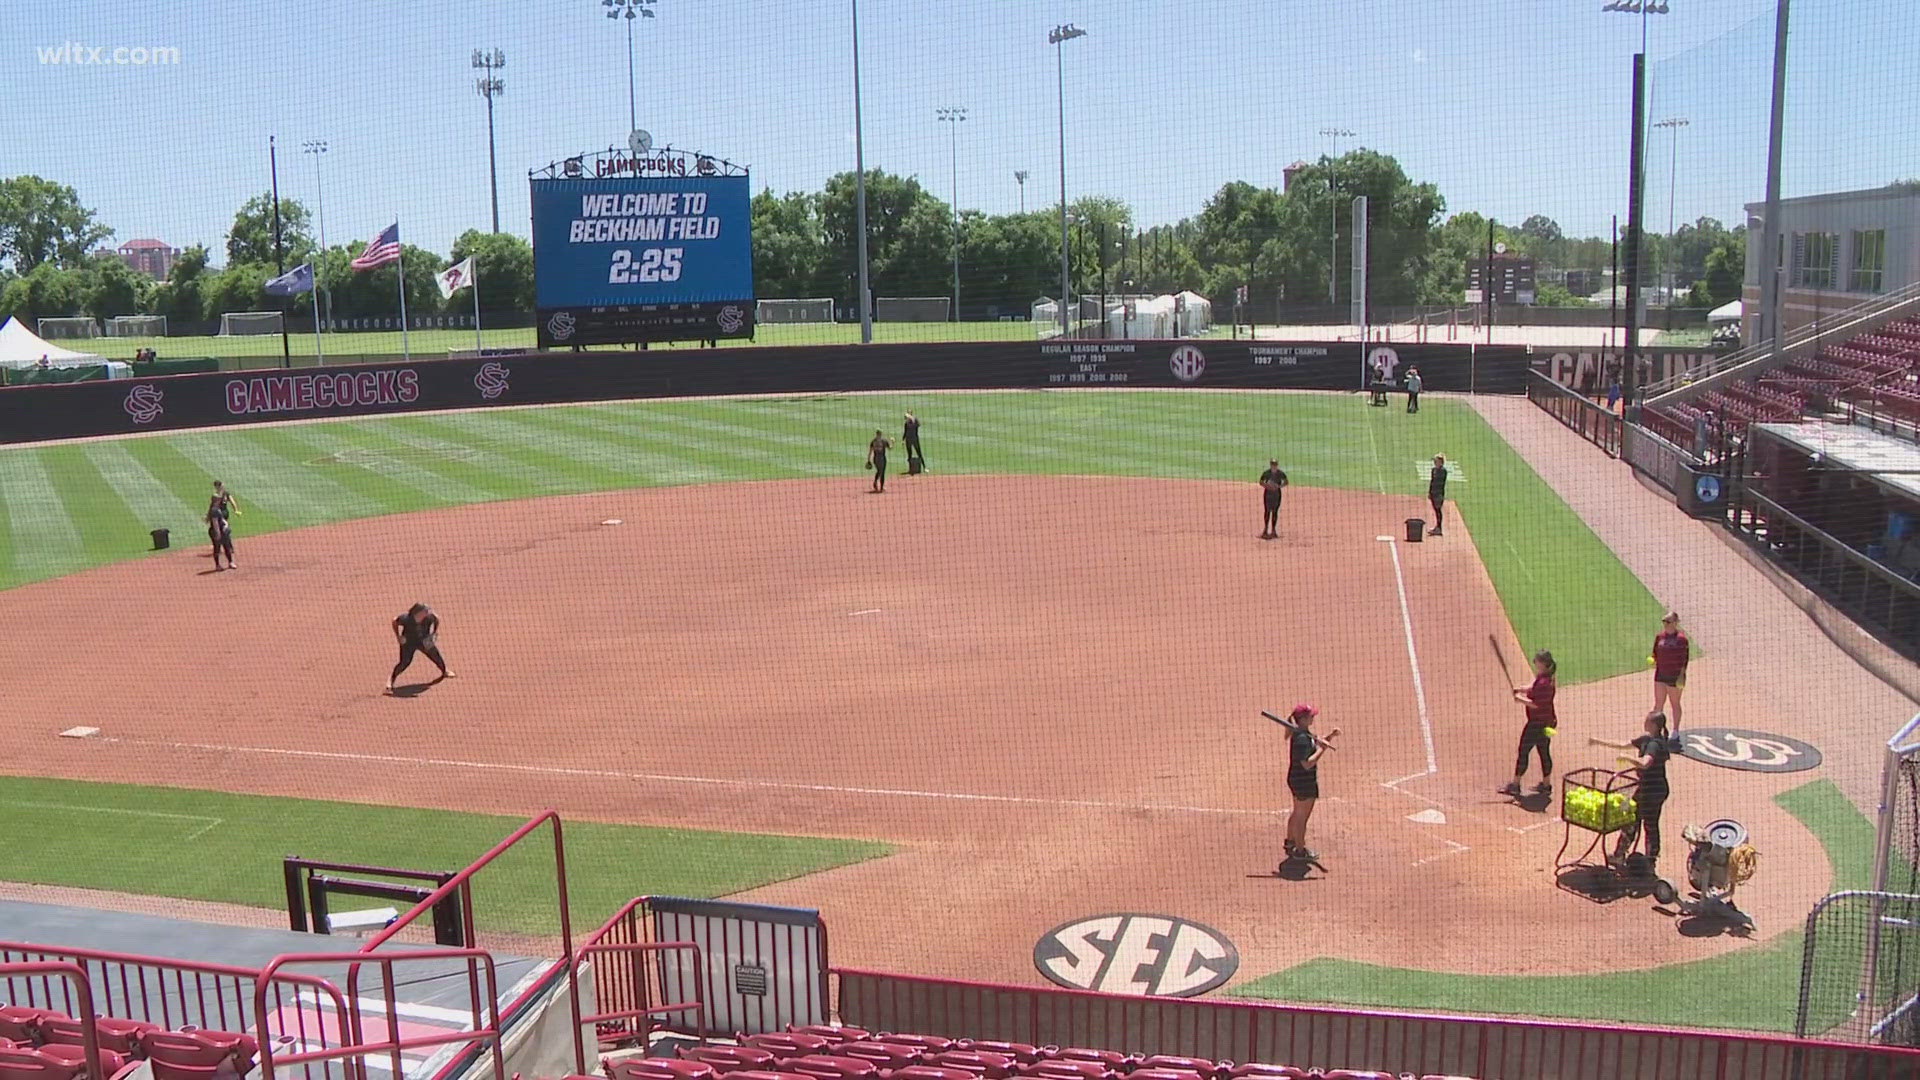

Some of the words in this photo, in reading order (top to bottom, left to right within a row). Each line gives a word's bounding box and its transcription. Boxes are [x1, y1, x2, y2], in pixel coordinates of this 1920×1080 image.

[582, 193, 678, 217] WELCOME
[683, 192, 708, 216] TO
[569, 218, 666, 243] BECKHAM
[669, 216, 720, 240] FIELD
[608, 247, 683, 284] 2:25
[1073, 344, 1099, 353] SEASON
[1101, 344, 1135, 353] CHAMPION
[1249, 347, 1294, 356] TOURNAMENT
[1295, 348, 1328, 356] CHAMPION
[1080, 364, 1097, 372] EAST
[1170, 346, 1205, 381] SEC
[225, 369, 419, 415] GAMECOCKS
[1045, 916, 1227, 995] SEC
[736, 966, 765, 976] CAUTION
